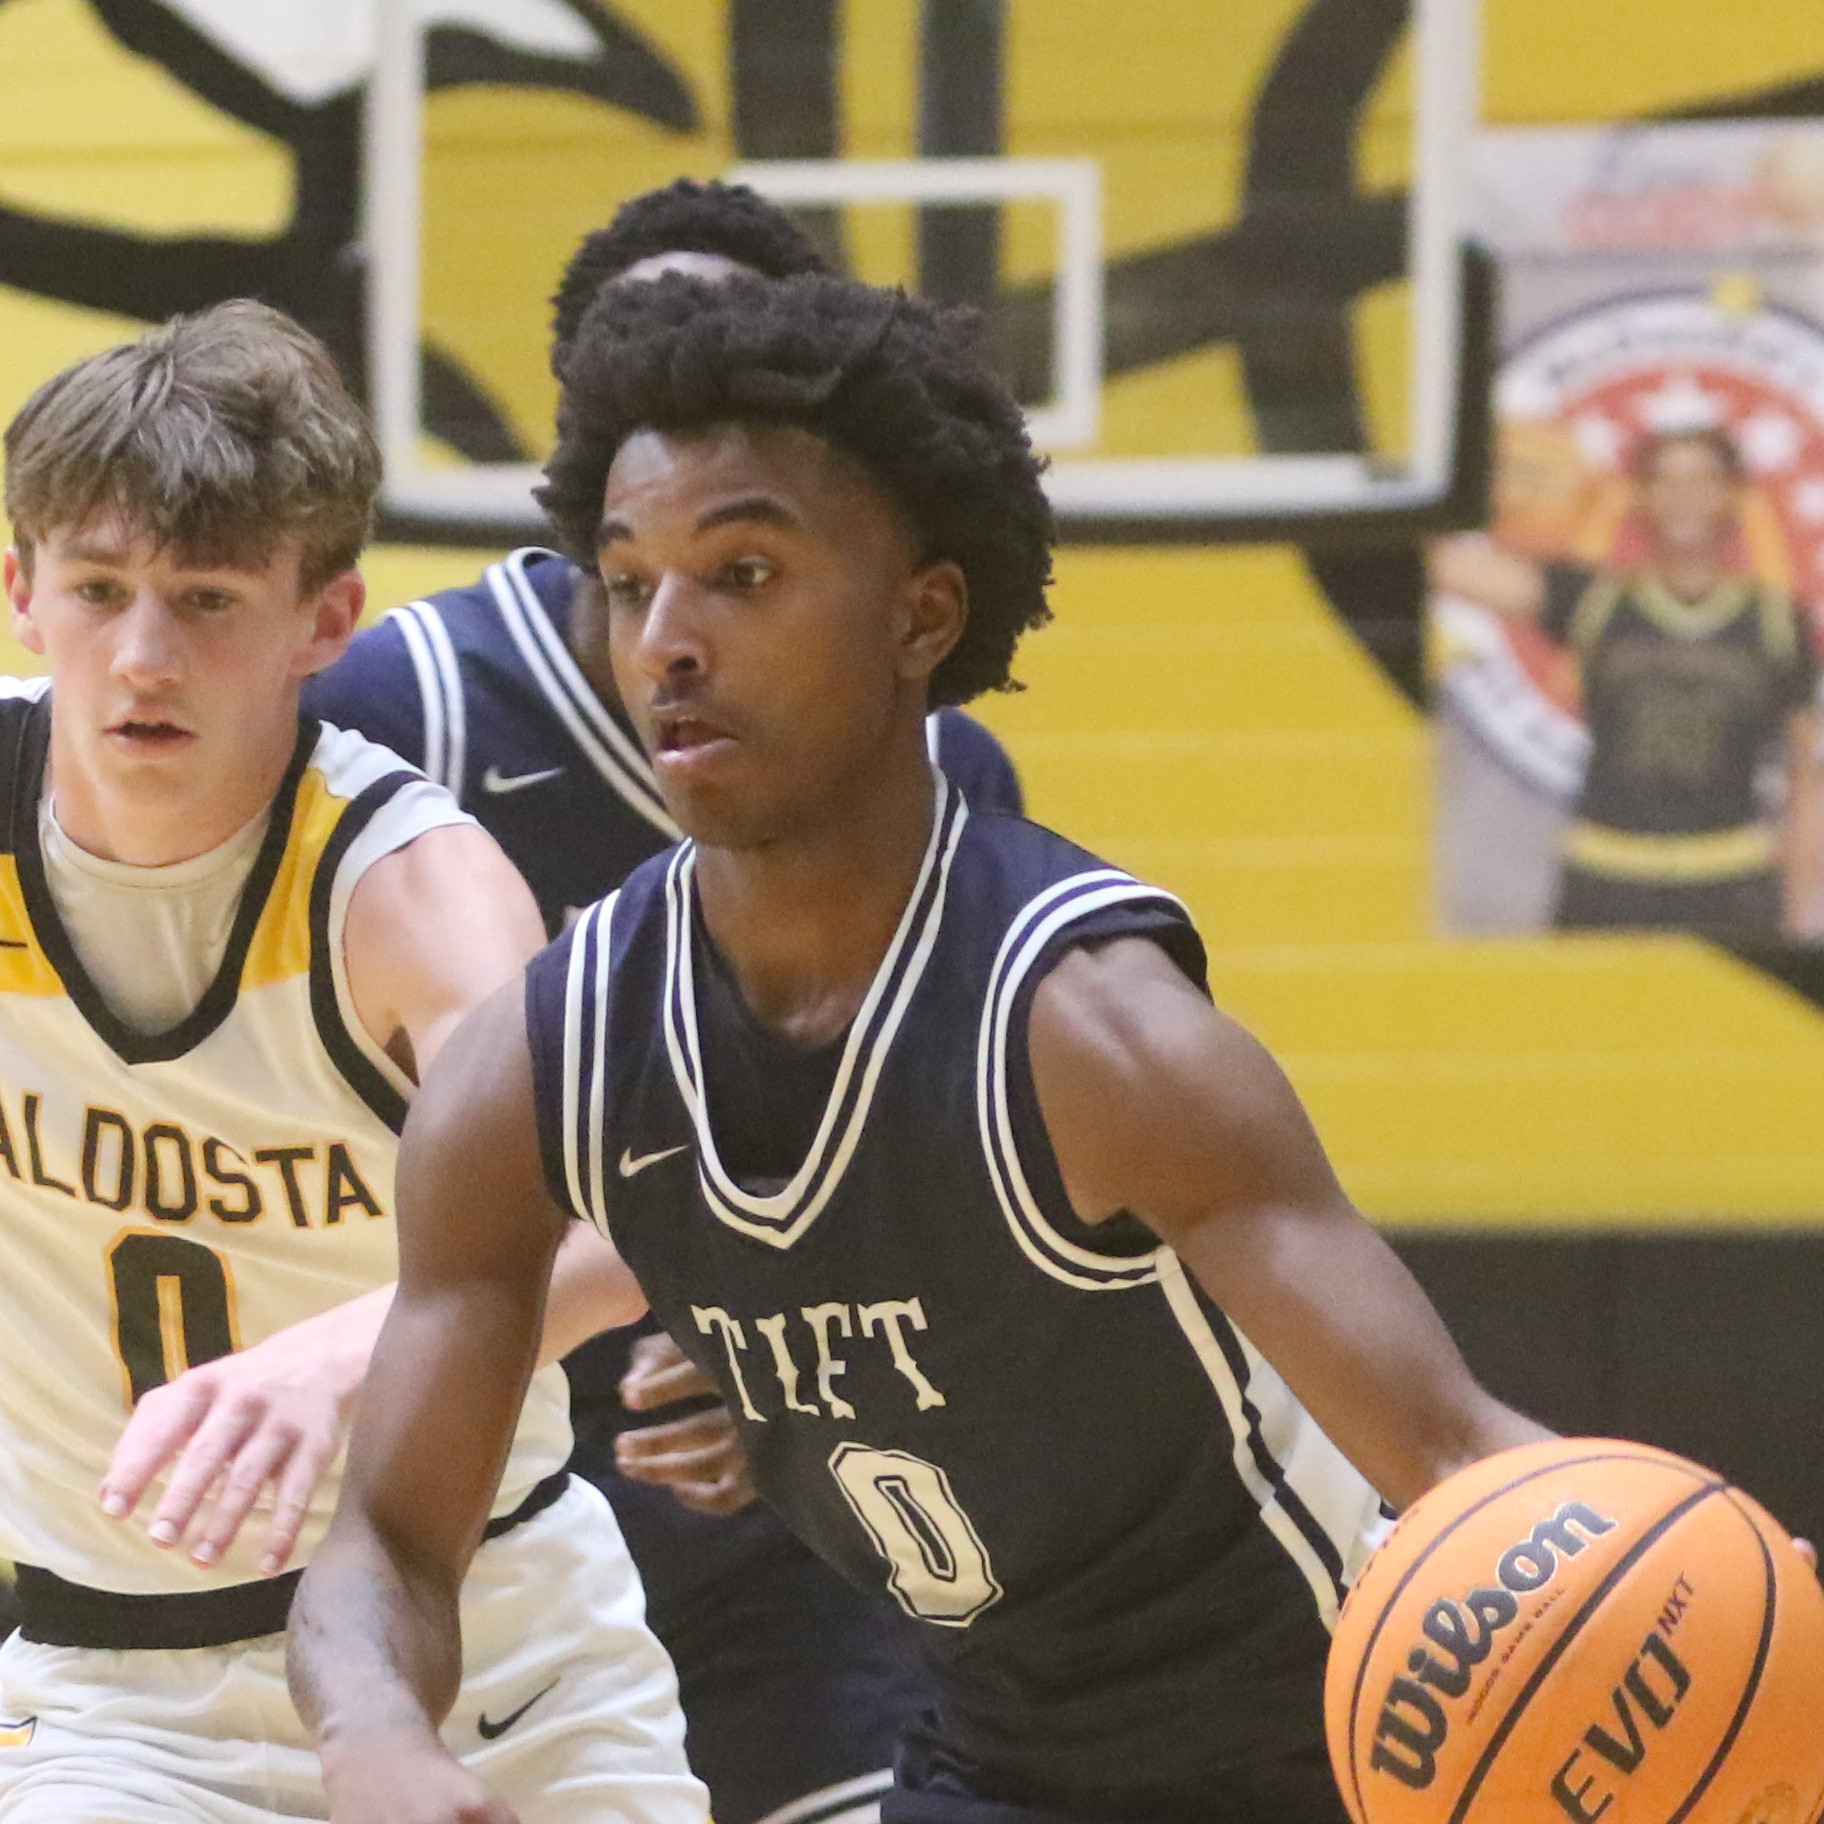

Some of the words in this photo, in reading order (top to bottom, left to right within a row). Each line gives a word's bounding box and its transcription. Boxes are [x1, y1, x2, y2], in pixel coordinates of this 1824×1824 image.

[105, 1227, 240, 1412] 0
[691, 1297, 946, 1422] TIFT
[828, 1441, 1005, 1629] 0
[1656, 1570, 1695, 1637] NXT
[1370, 1498, 1618, 1791] Wilson
